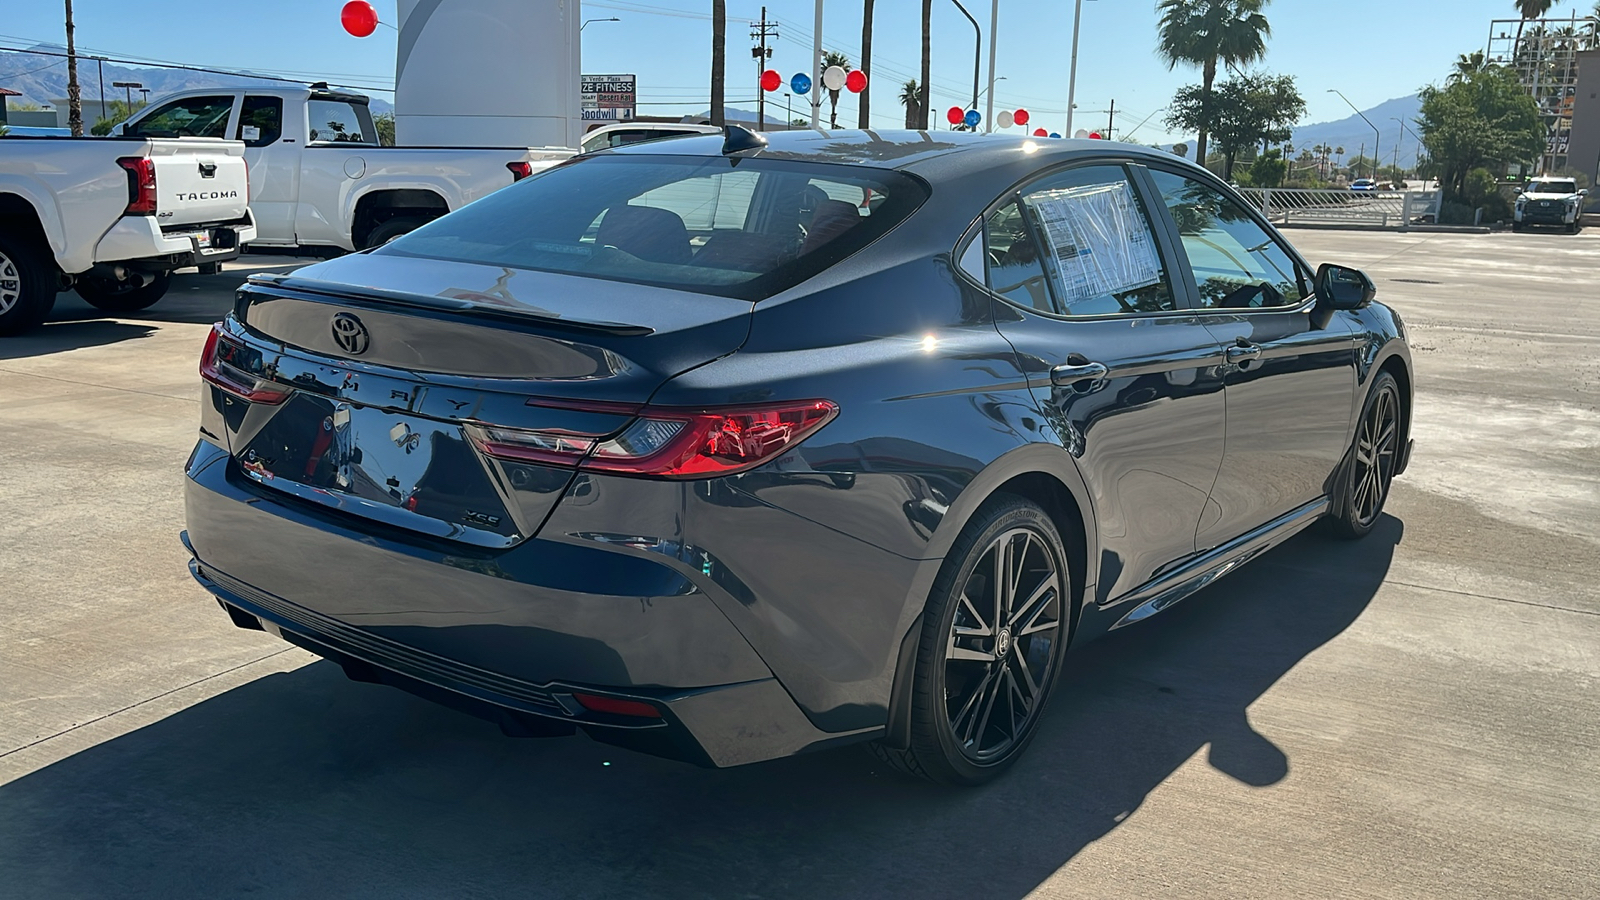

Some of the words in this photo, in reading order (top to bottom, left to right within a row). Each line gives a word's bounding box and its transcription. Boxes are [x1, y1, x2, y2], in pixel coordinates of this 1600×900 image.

[582, 83, 594, 92] ZE
[596, 83, 633, 92] FITNESS
[176, 190, 238, 201] TACOMA
[991, 510, 1038, 531] BRIDGESTONE
